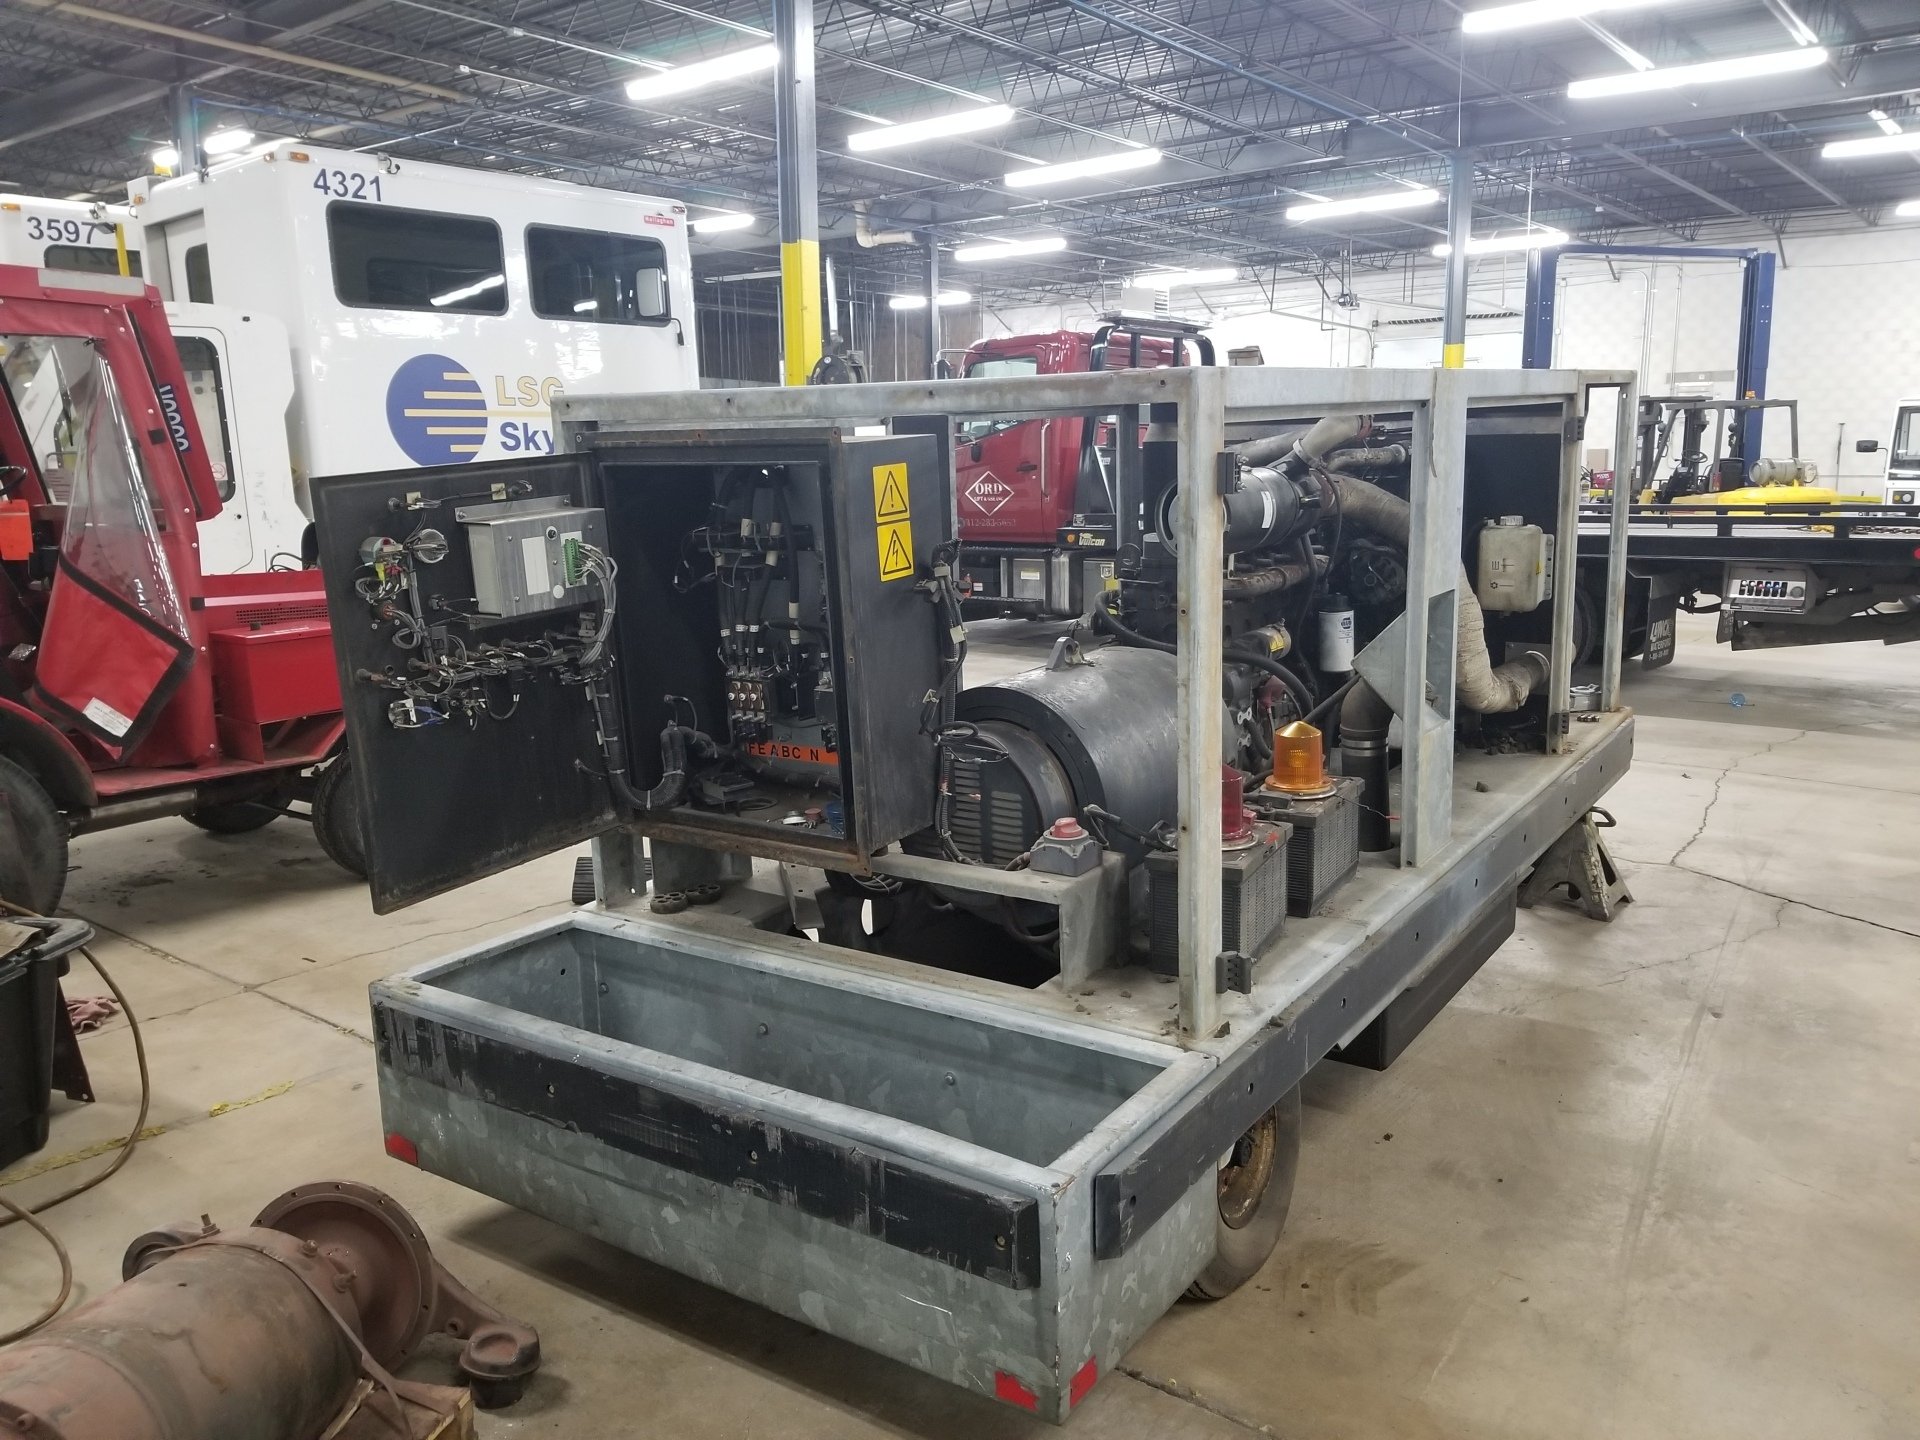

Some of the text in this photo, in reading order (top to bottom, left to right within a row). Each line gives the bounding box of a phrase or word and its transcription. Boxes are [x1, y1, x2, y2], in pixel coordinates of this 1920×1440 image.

[313, 168, 381, 202] 4321
[27, 216, 97, 244] 3597
[975, 483, 1003, 495] ORD
